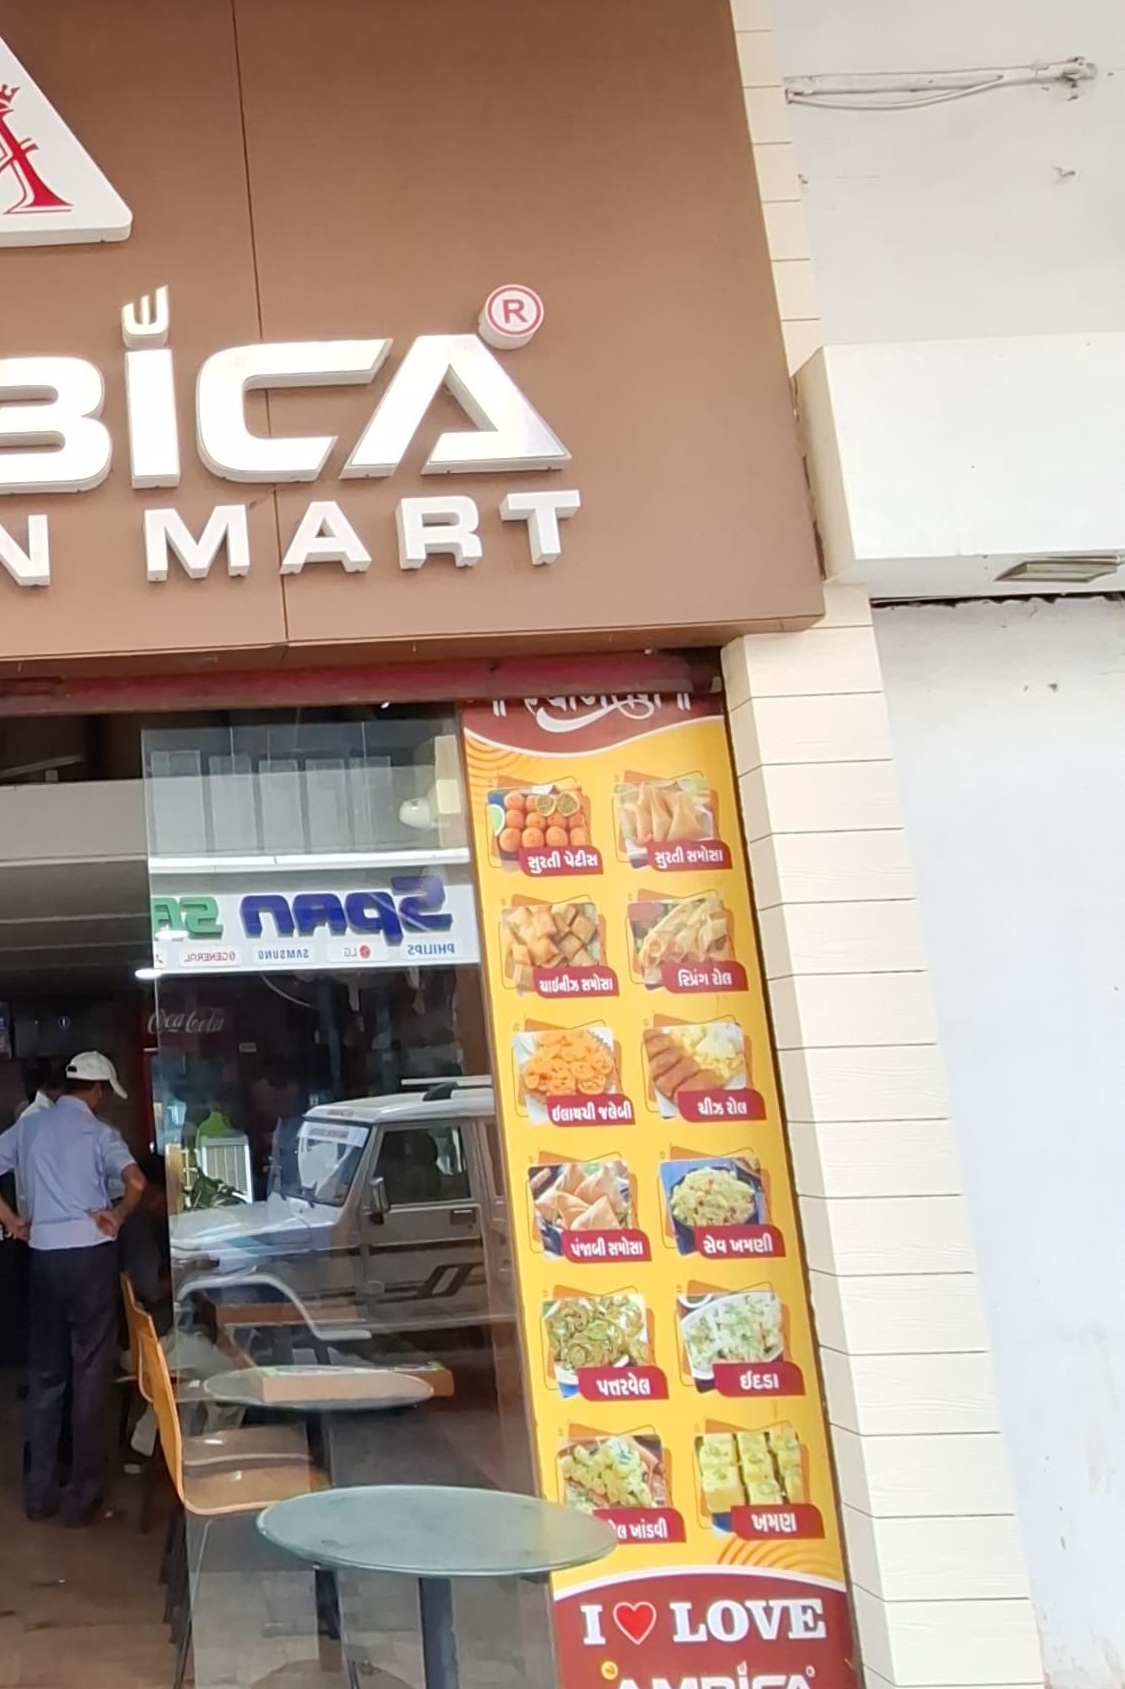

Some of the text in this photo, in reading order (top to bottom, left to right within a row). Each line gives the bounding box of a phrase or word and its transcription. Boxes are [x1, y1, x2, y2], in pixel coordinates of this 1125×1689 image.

[144, 489, 581, 582] MART
[527, 849, 599, 874] સુરતી પેટીસ
[654, 845, 724, 869] સુરતી સમોસા
[580, 973, 613, 991] સમોસા
[711, 967, 732, 986] રોલ
[597, 1100, 632, 1120] જલેબી
[697, 1096, 747, 1116] ચીઝ રોલ
[570, 1236, 643, 1258] પંજાબી સમોસા
[702, 1232, 773, 1255] સેવ ખમણી
[629, 1517, 668, 1539] ખાંડવી
[750, 1513, 797, 1533] ખમણ
[580, 1598, 827, 1645] I LOVE
